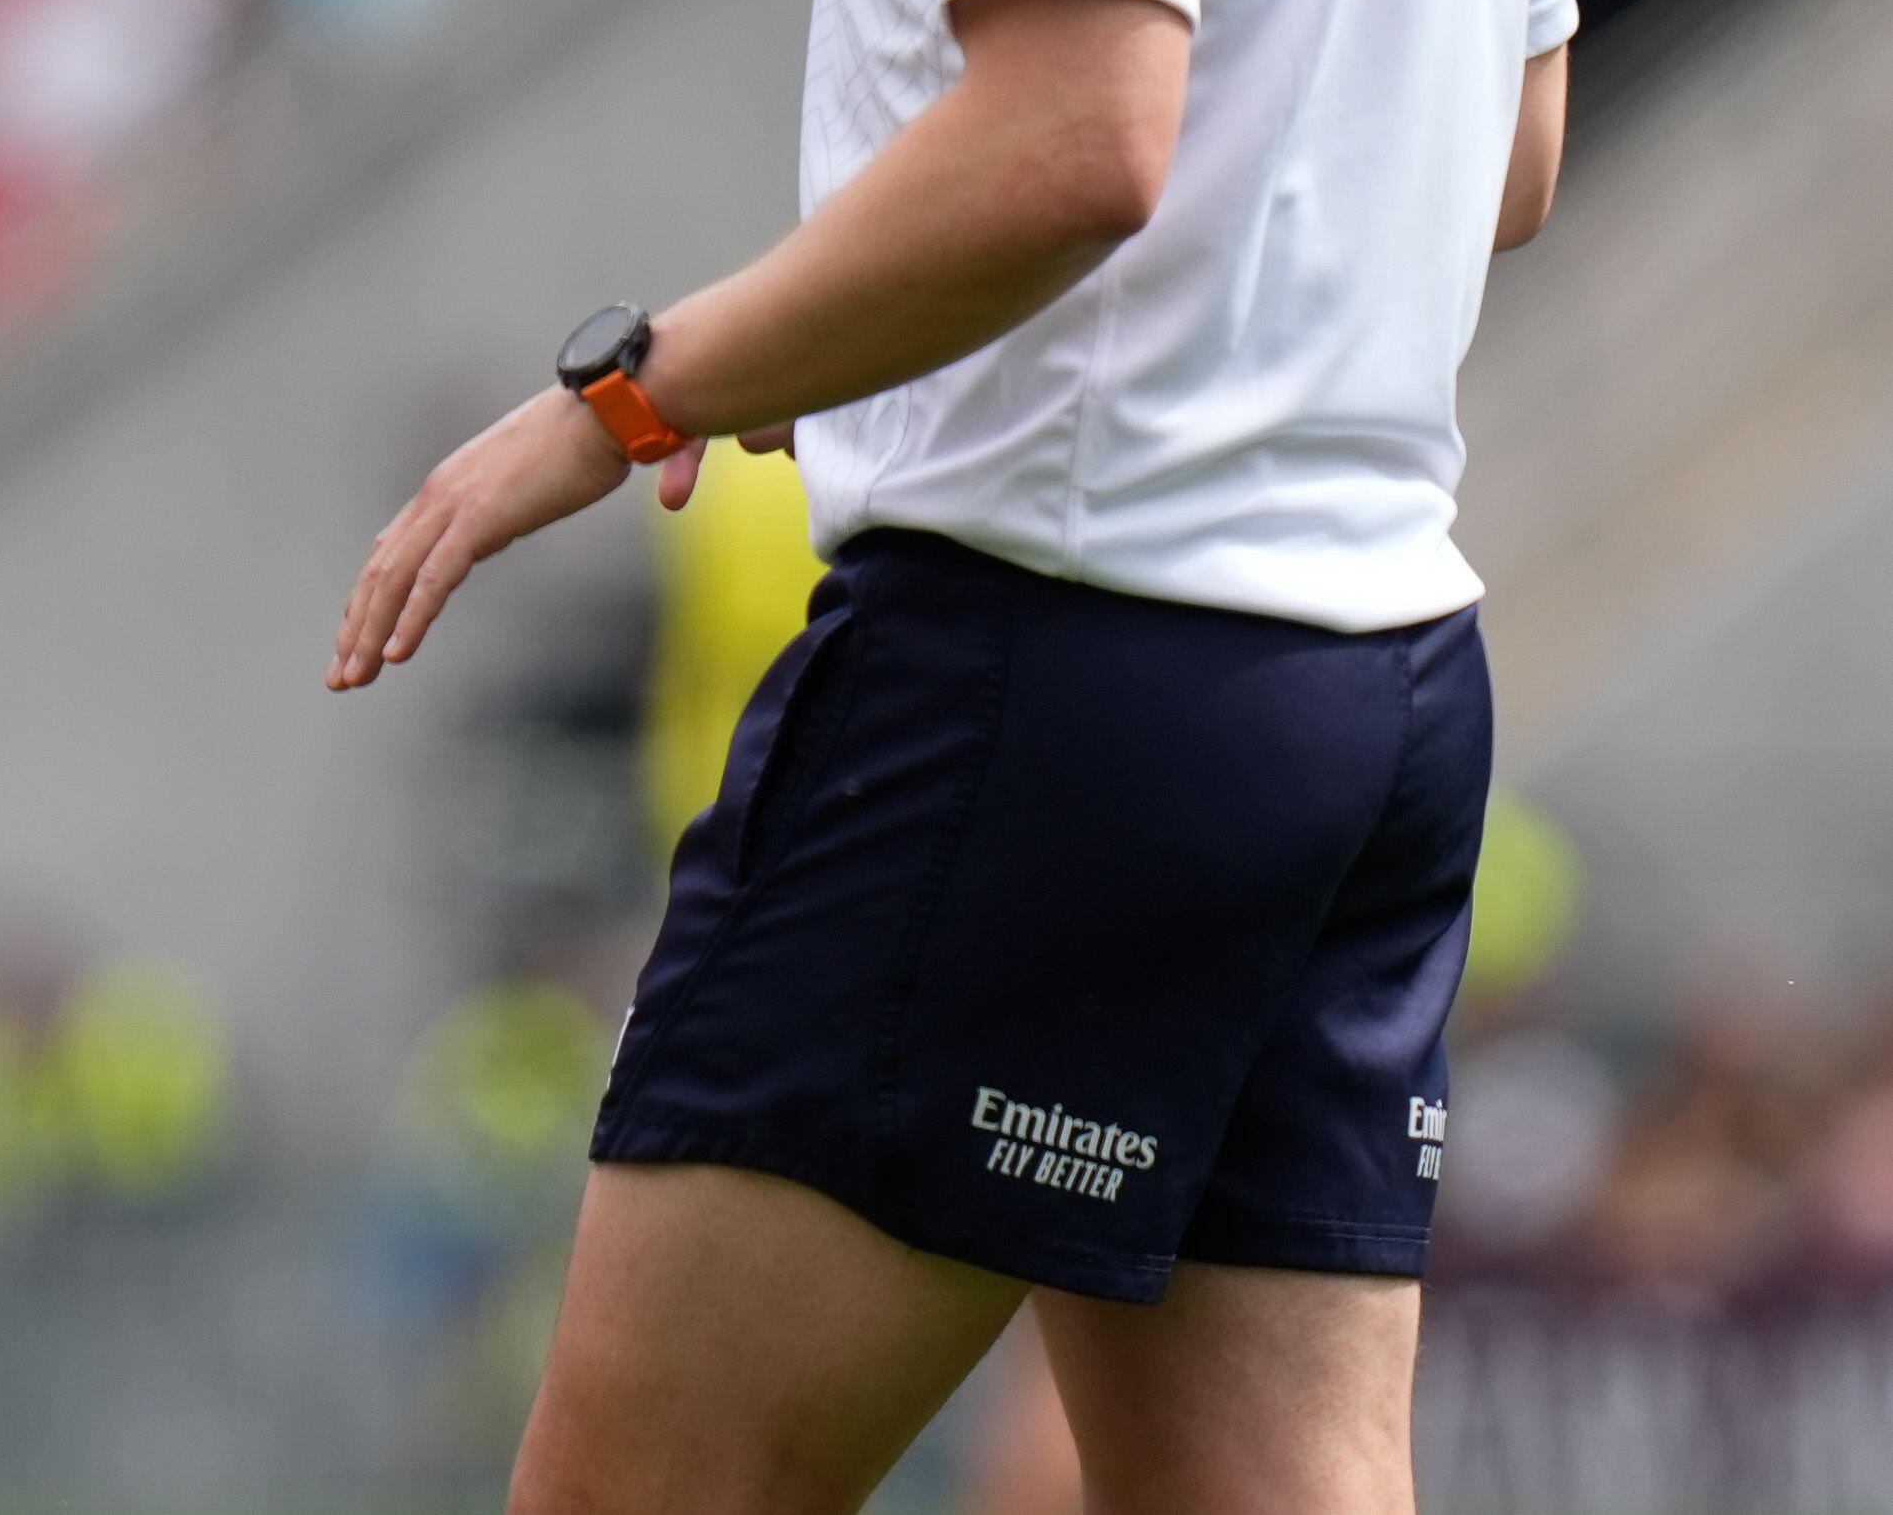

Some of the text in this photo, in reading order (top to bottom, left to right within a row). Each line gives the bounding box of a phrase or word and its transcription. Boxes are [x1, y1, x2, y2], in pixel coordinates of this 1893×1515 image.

[971, 1085, 1157, 1170] Emirates
[987, 1137, 1125, 1203] FLY BETTER
